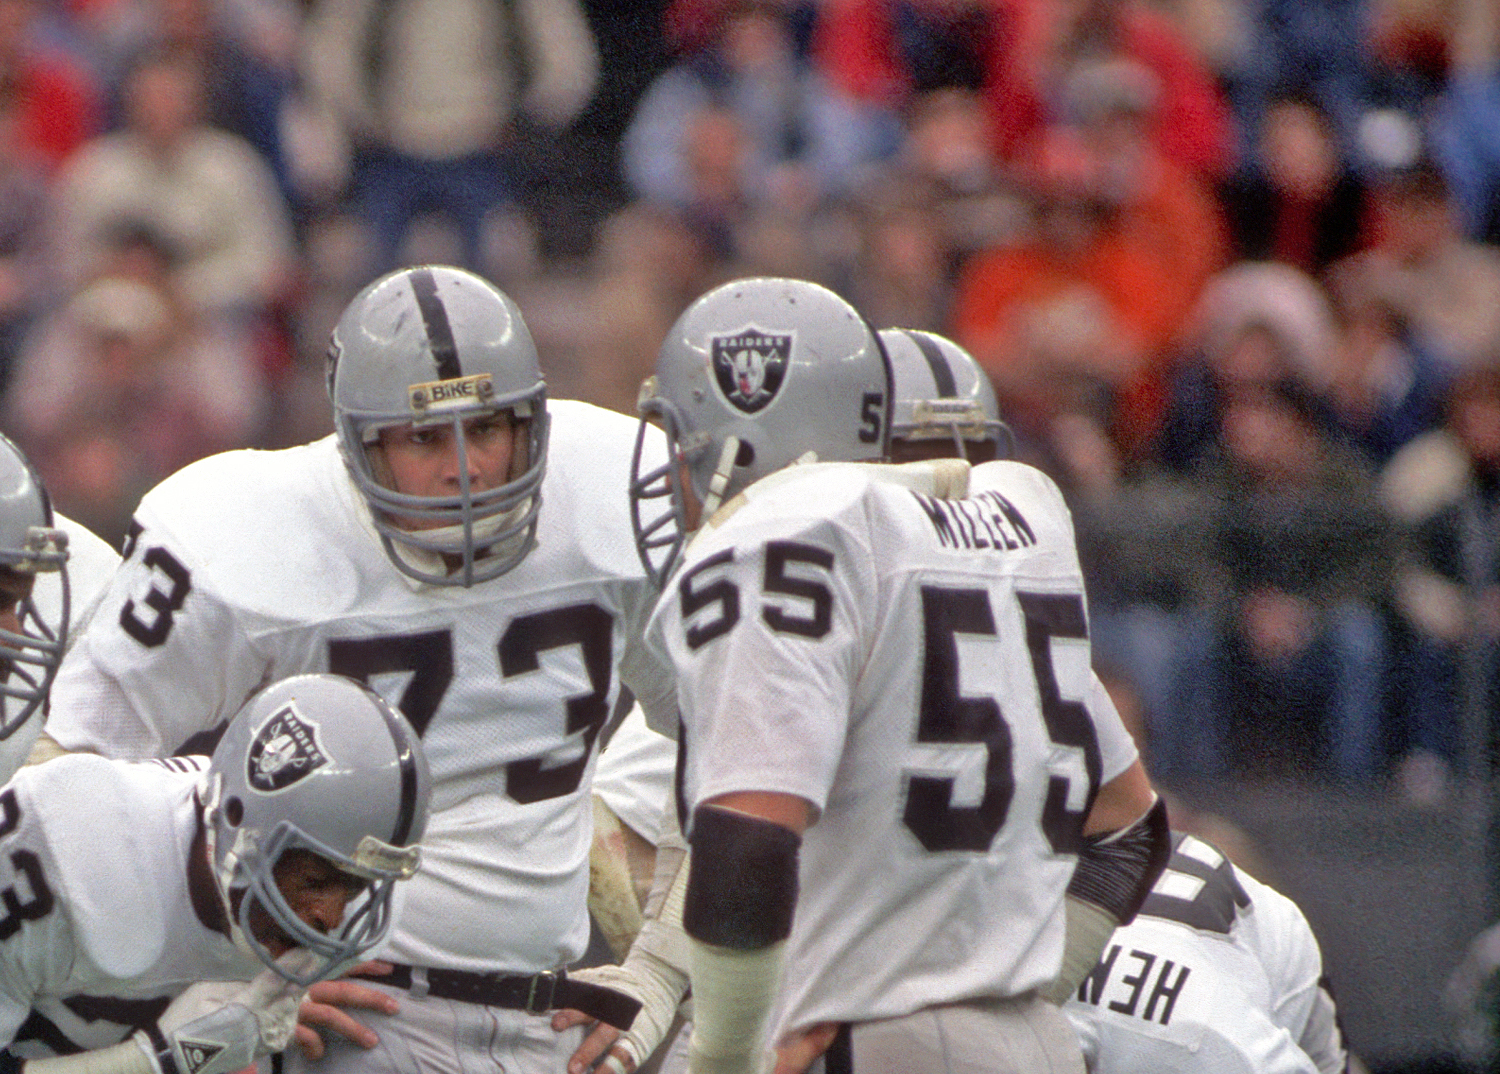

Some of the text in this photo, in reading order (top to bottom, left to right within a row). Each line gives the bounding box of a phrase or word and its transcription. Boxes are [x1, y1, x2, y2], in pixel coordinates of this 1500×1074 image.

[719, 337, 784, 348] RAIDERS
[858, 392, 884, 444] 5
[909, 489, 1037, 551] MILLEN
[680, 539, 835, 651] 55
[328, 602, 614, 805] 73
[903, 585, 1104, 855] 55
[283, 711, 321, 762] RAIDERS
